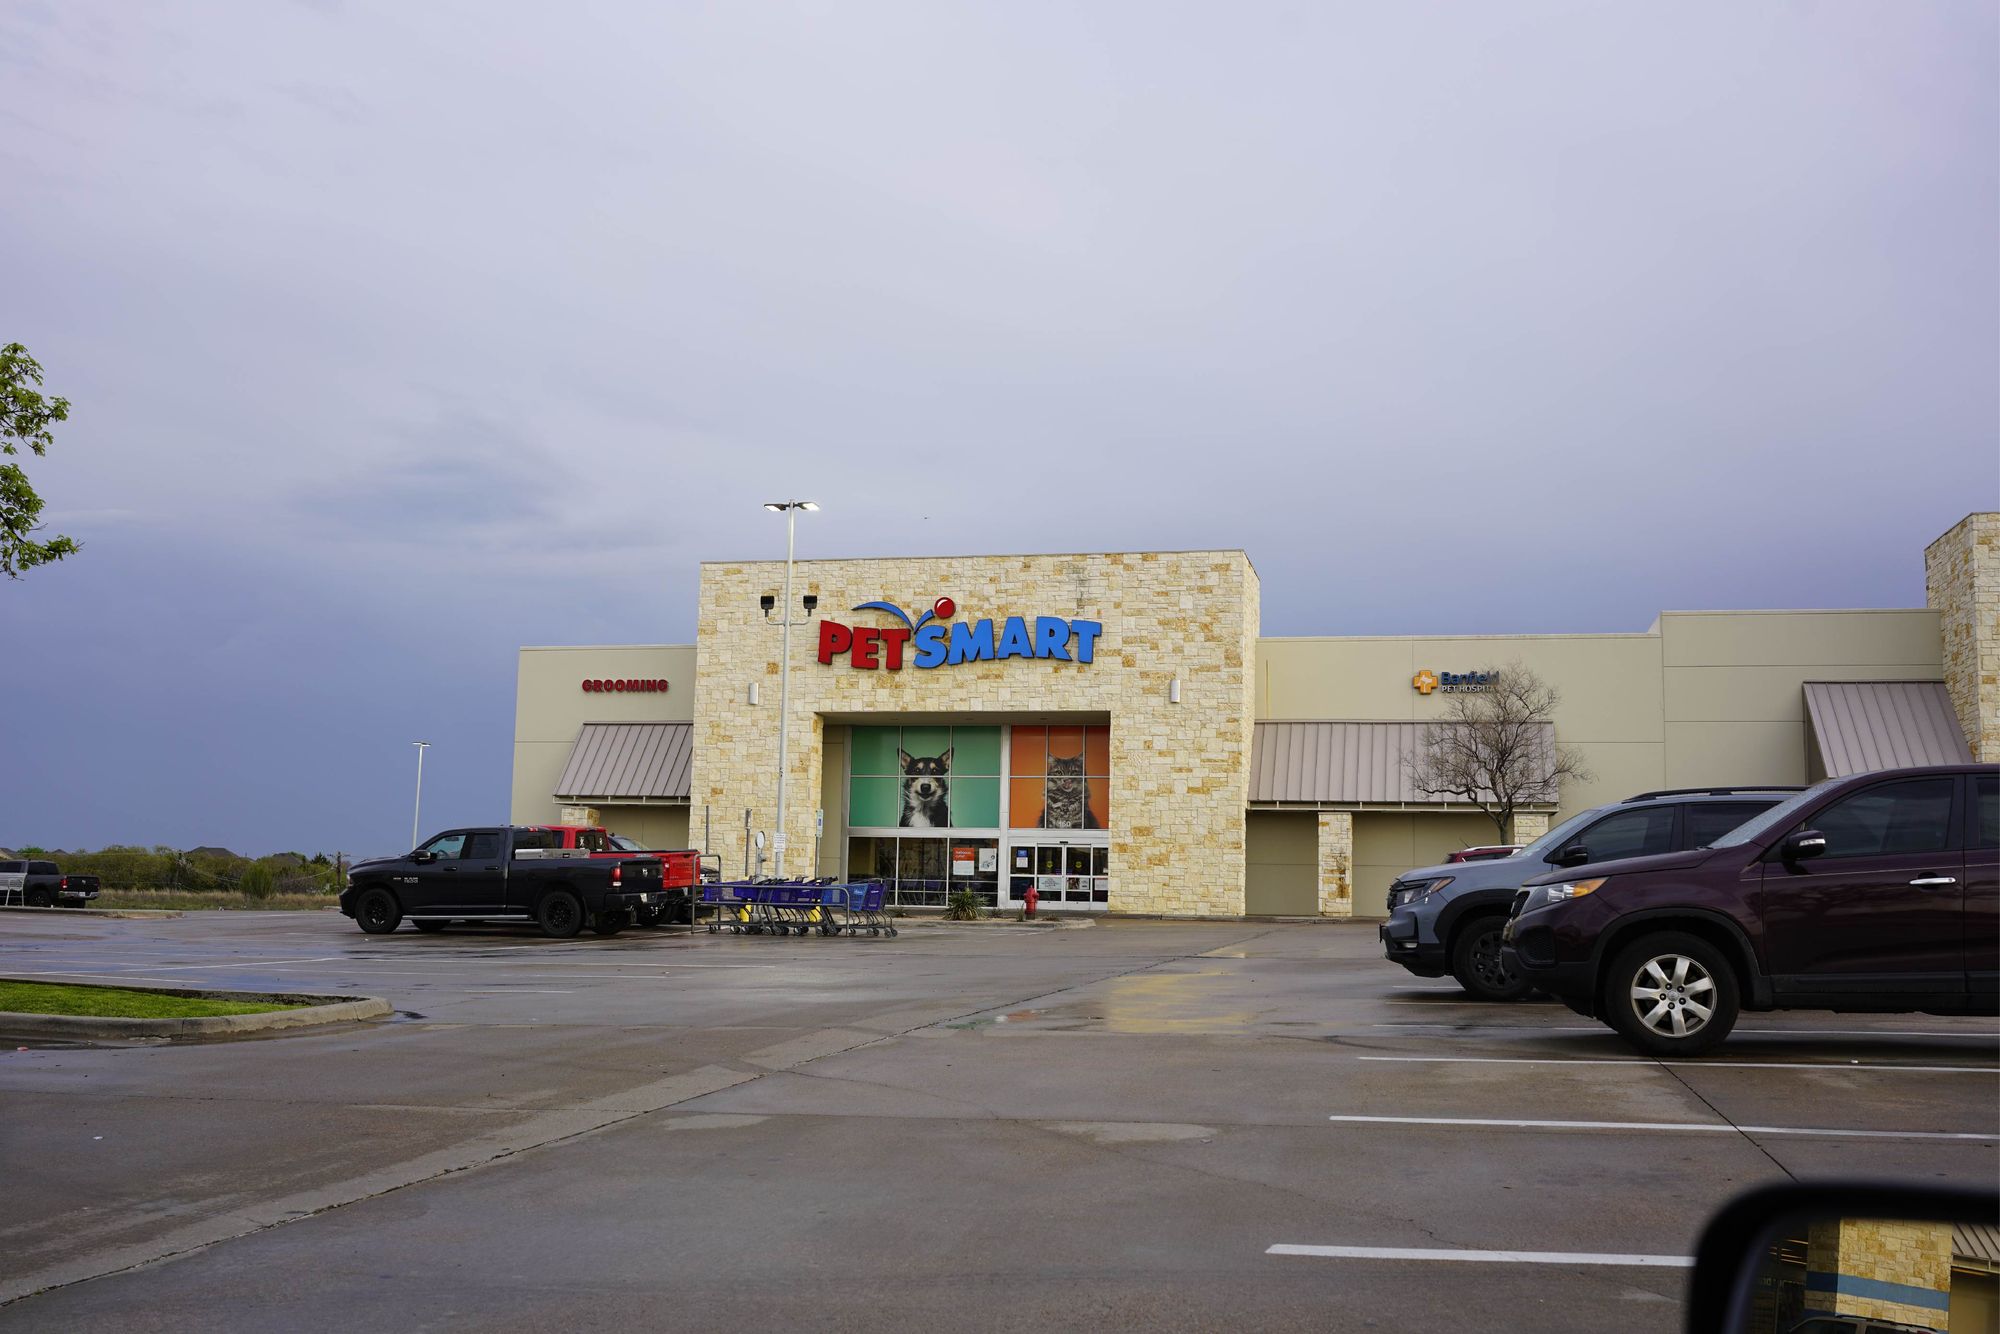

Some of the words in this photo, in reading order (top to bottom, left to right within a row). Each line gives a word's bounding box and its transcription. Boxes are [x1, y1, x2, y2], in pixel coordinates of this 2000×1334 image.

[817, 616, 1102, 670] PETSMART
[582, 679, 669, 693] GROOMING
[1441, 685, 1457, 693] PET
